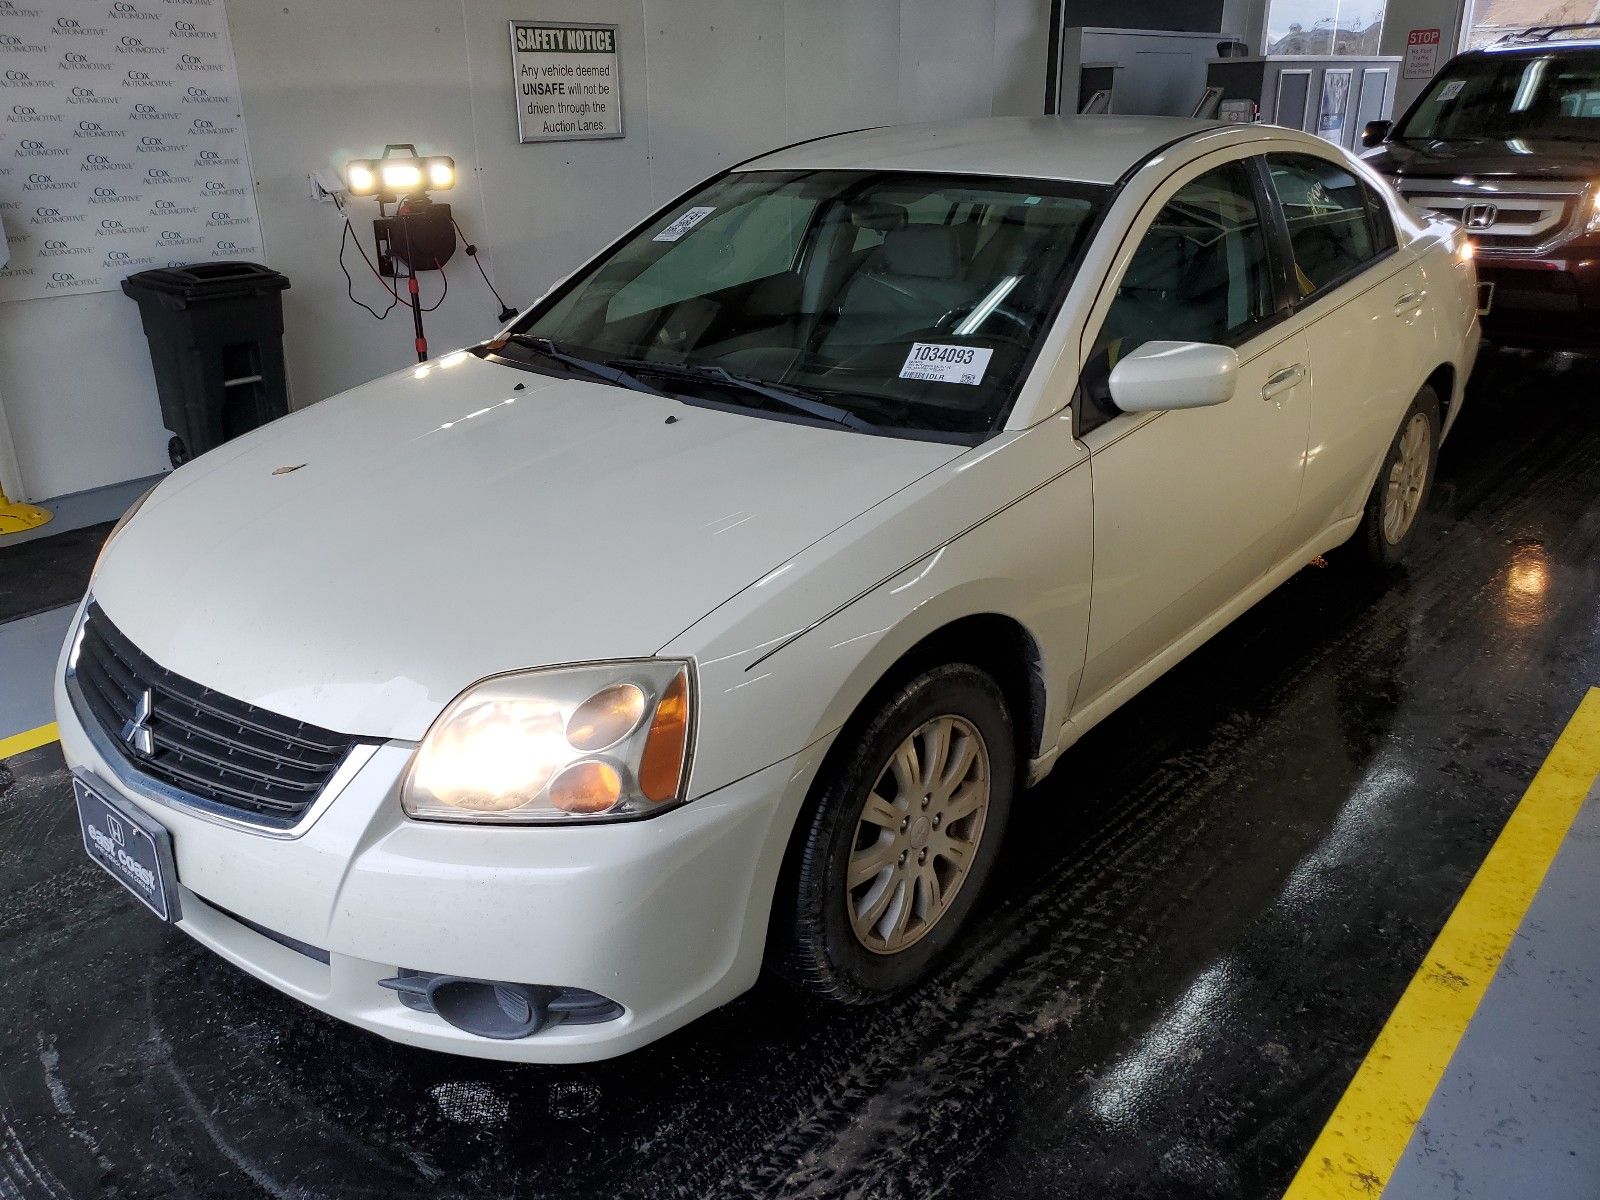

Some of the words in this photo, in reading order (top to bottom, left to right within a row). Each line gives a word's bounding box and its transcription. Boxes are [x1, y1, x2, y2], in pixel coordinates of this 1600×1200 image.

[517, 29, 564, 50] SAFETY
[566, 30, 612, 50] NOTICE
[1410, 32, 1438, 44] STOP
[521, 64, 539, 79] Any
[542, 64, 574, 76] vehicle
[576, 64, 610, 76] deemed
[522, 83, 565, 96] UNSAFE
[568, 83, 581, 94] will
[584, 84, 596, 94] not
[598, 83, 610, 94] be
[528, 102, 555, 114] driven
[558, 101, 590, 116] through
[592, 101, 606, 112] the
[543, 120, 576, 132] Auction
[578, 120, 606, 132] Lanes.
[914, 346, 974, 364] 1034093
